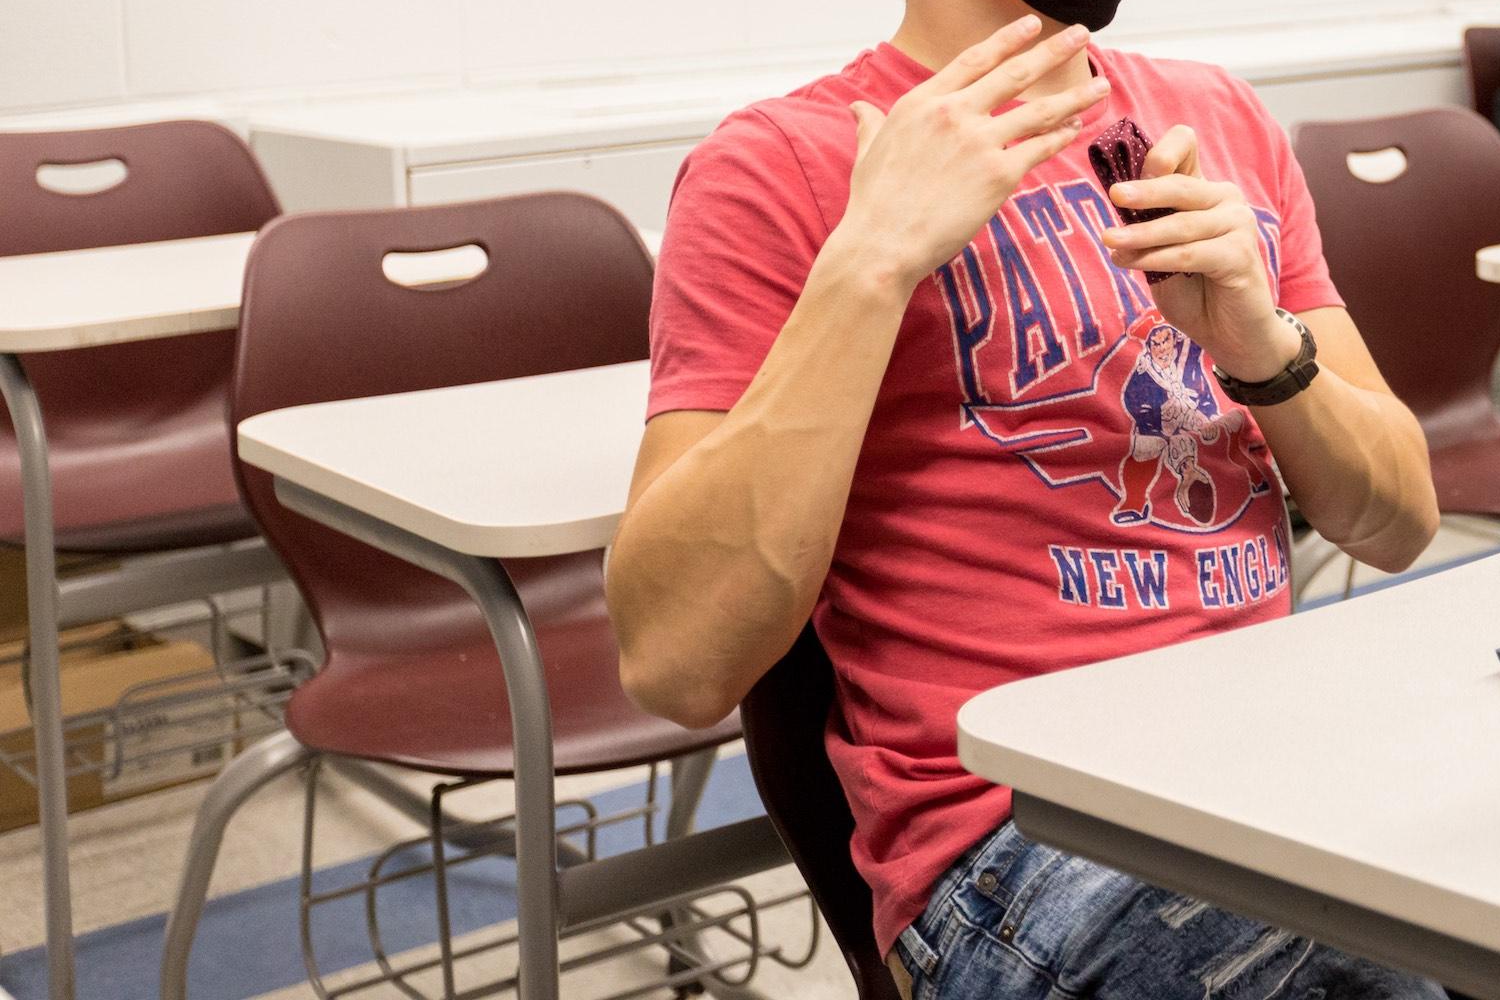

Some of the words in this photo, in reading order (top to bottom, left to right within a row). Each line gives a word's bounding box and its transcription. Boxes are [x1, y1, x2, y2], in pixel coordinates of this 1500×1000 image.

[932, 178, 1281, 406] PATR
[1050, 545, 1169, 610] NEW
[1196, 525, 1288, 609] ENGLA
